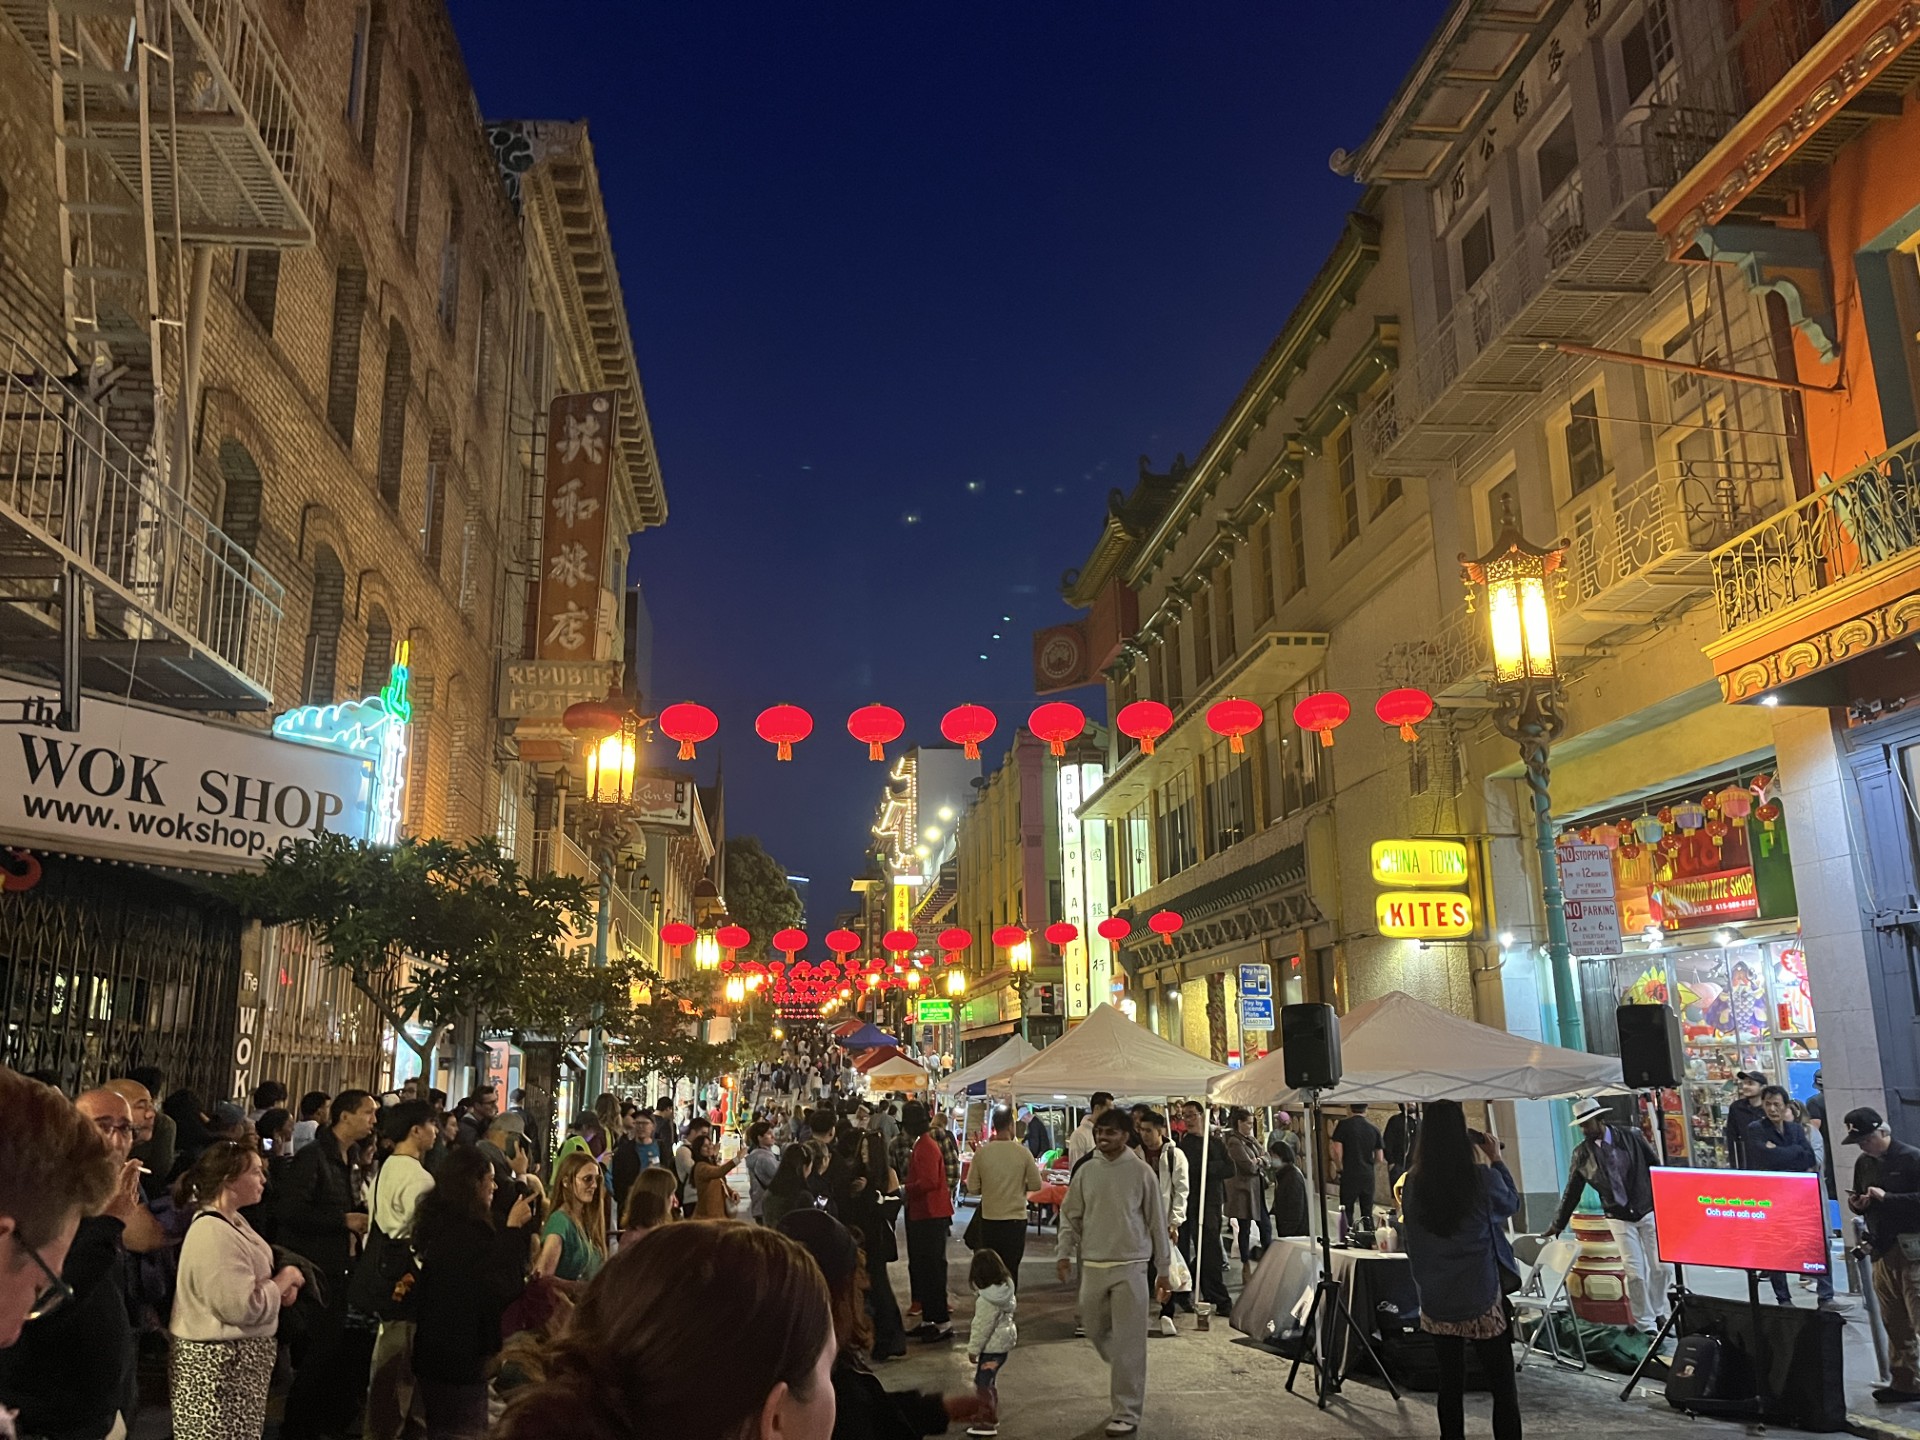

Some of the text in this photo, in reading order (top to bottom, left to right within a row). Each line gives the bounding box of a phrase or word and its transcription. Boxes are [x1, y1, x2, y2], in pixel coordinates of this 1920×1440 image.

[19, 732, 343, 837] WOK SHOP
[1382, 848, 1465, 874] CHINA TOWN
[1560, 847, 1609, 862] NO STOPPING
[1065, 773, 1083, 1009] Bank of Amrica
[1711, 877, 1729, 899] KITE
[1730, 873, 1753, 897] SHOP
[1390, 902, 1466, 927] KITES
[1565, 903, 1615, 917] NO PARKING
[233, 969, 258, 1098] The WOK
